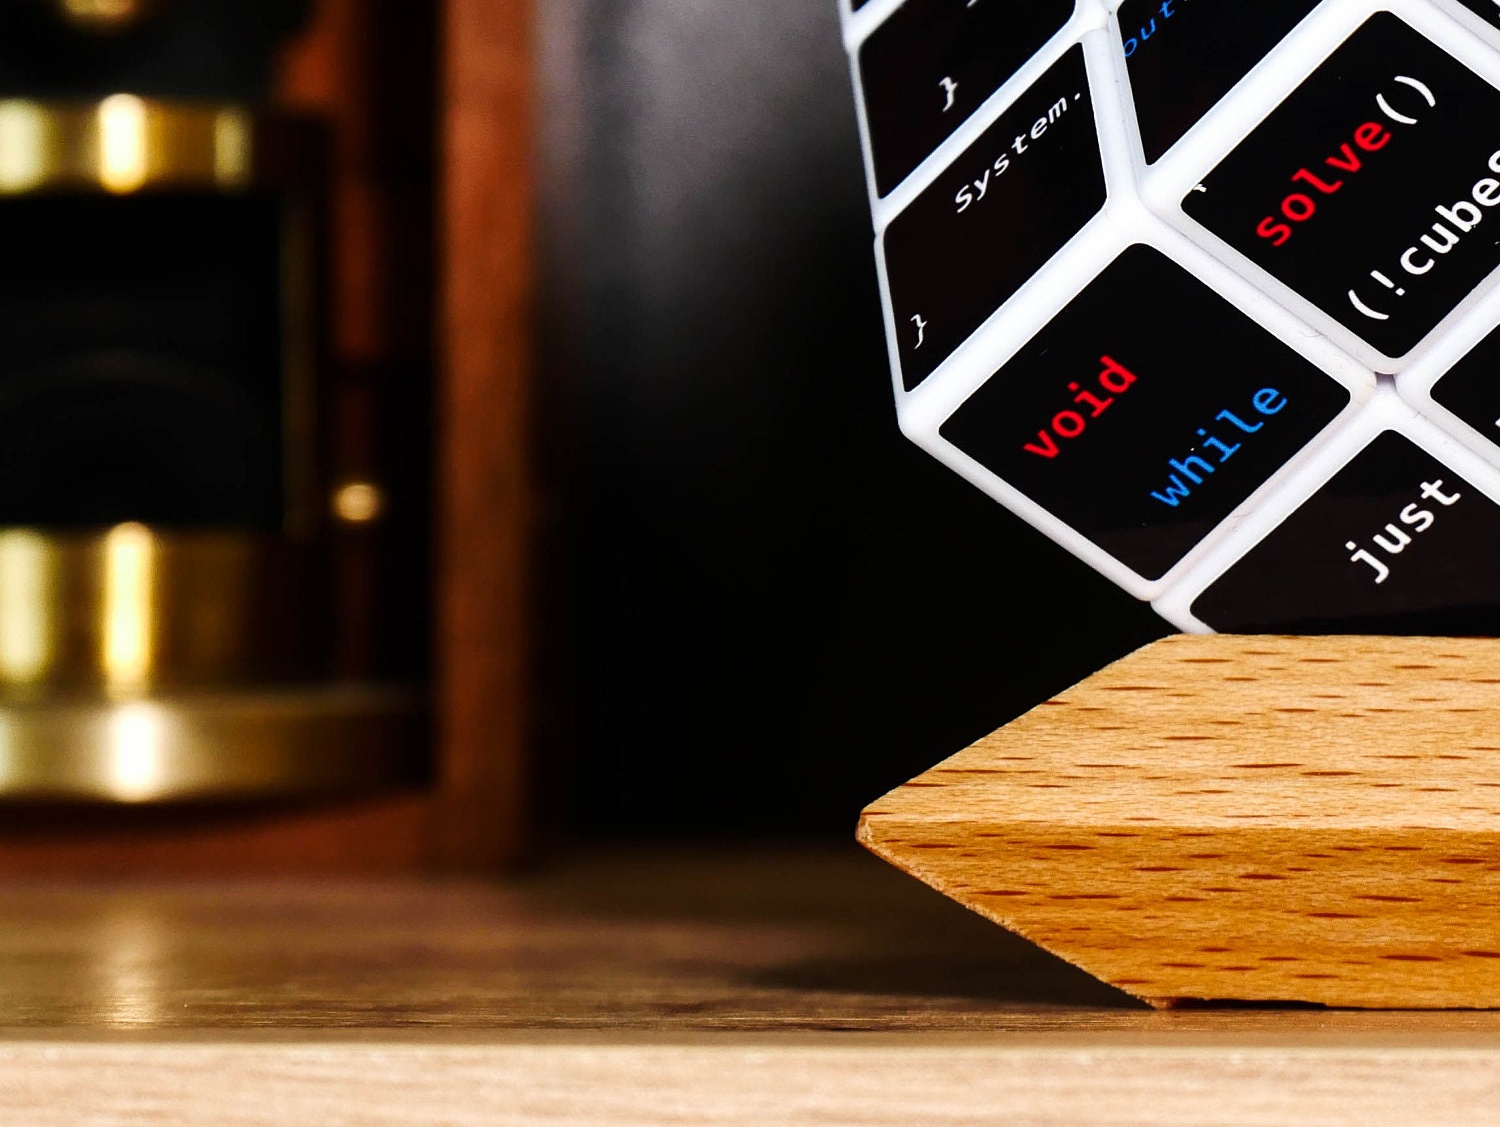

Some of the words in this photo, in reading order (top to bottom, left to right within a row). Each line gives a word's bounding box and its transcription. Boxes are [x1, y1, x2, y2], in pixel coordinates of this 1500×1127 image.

[954, 92, 1081, 214] System.
[1022, 354, 1138, 459] void
[1255, 75, 1436, 247] solve()
[1149, 387, 1288, 508] while
[1345, 479, 1461, 584] just
